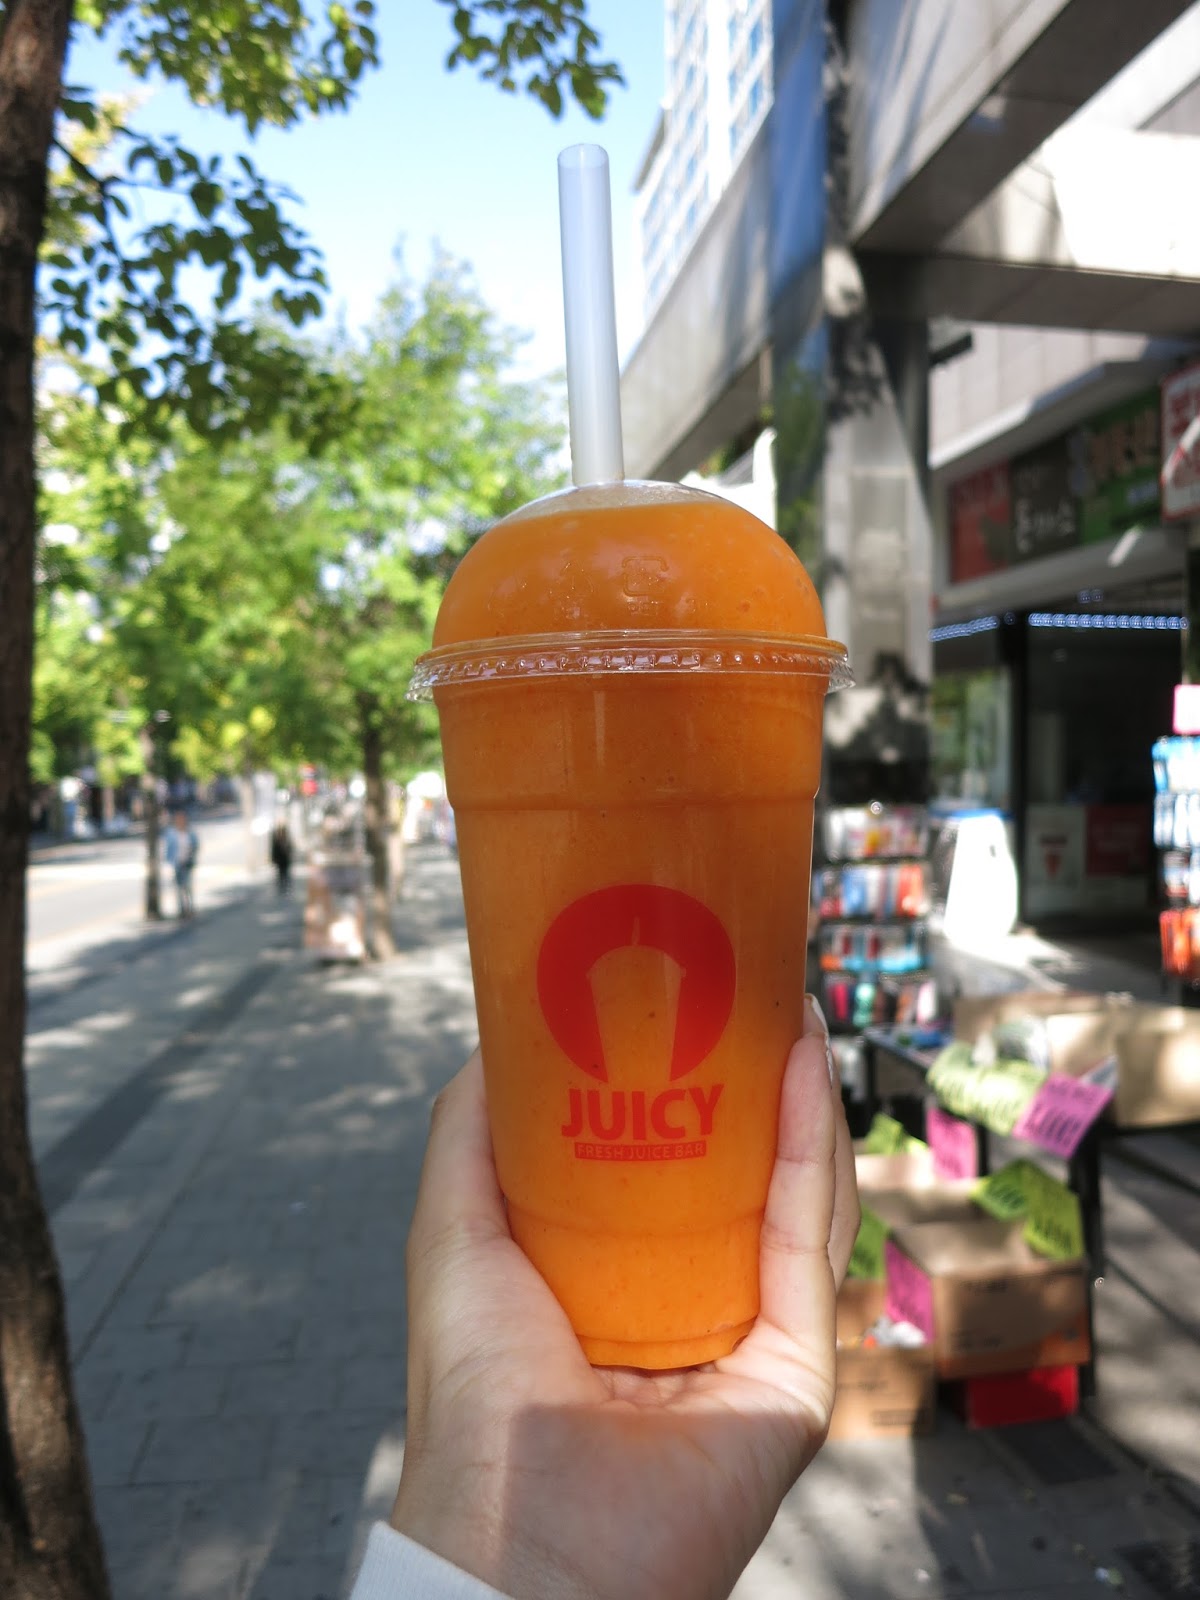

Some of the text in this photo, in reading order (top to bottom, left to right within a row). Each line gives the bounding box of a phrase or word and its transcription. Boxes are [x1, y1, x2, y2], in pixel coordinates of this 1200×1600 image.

[562, 1084, 724, 1140] JUICY
[577, 1143, 704, 1160] FRESH JUICE BAR
